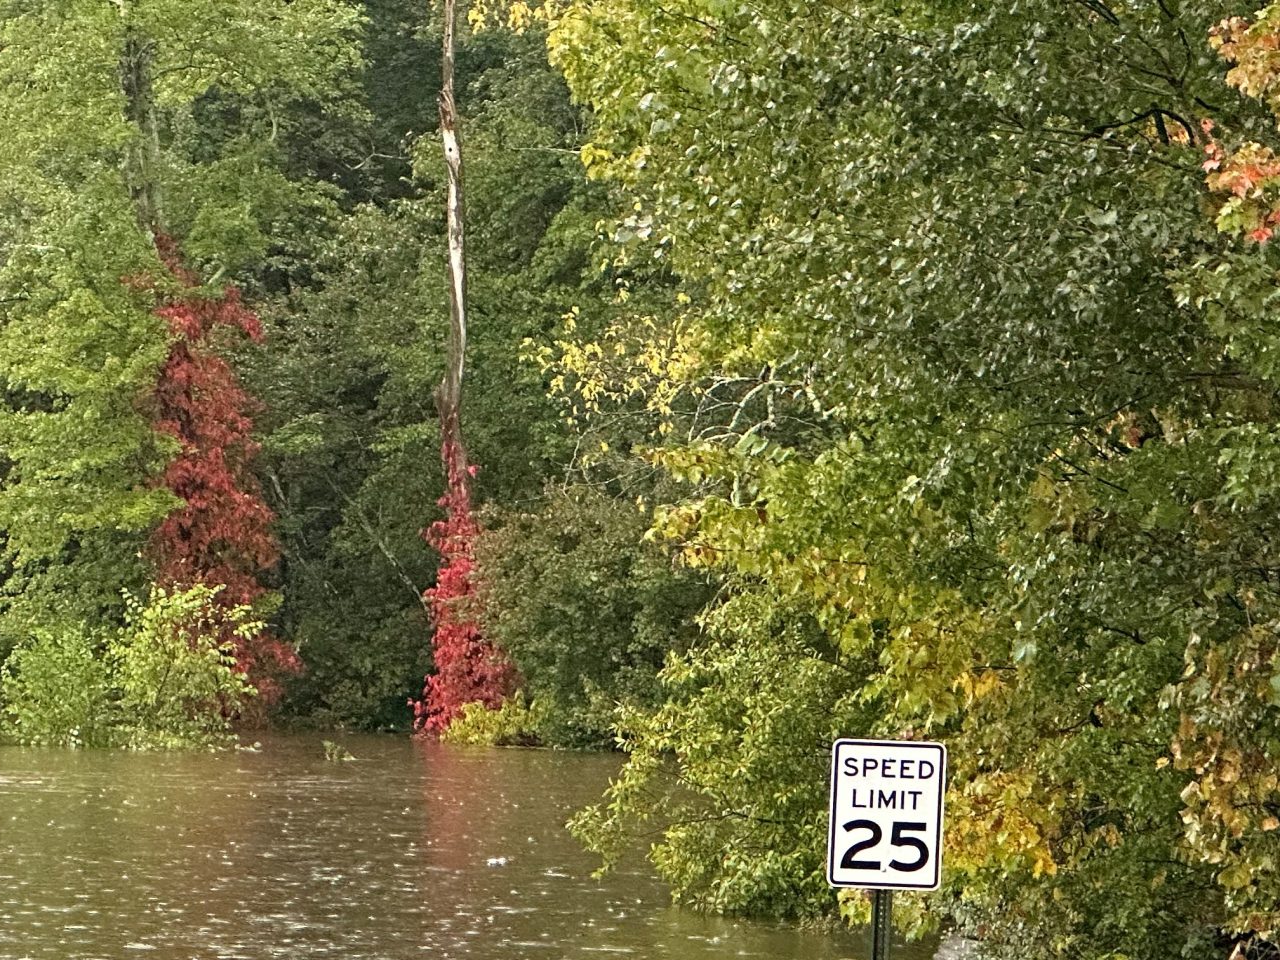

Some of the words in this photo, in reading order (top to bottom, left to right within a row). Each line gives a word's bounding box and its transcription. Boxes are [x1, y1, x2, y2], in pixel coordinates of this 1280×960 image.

[843, 757, 935, 780] SPEED
[852, 788, 923, 810] LIMIT
[839, 819, 930, 873] 25
